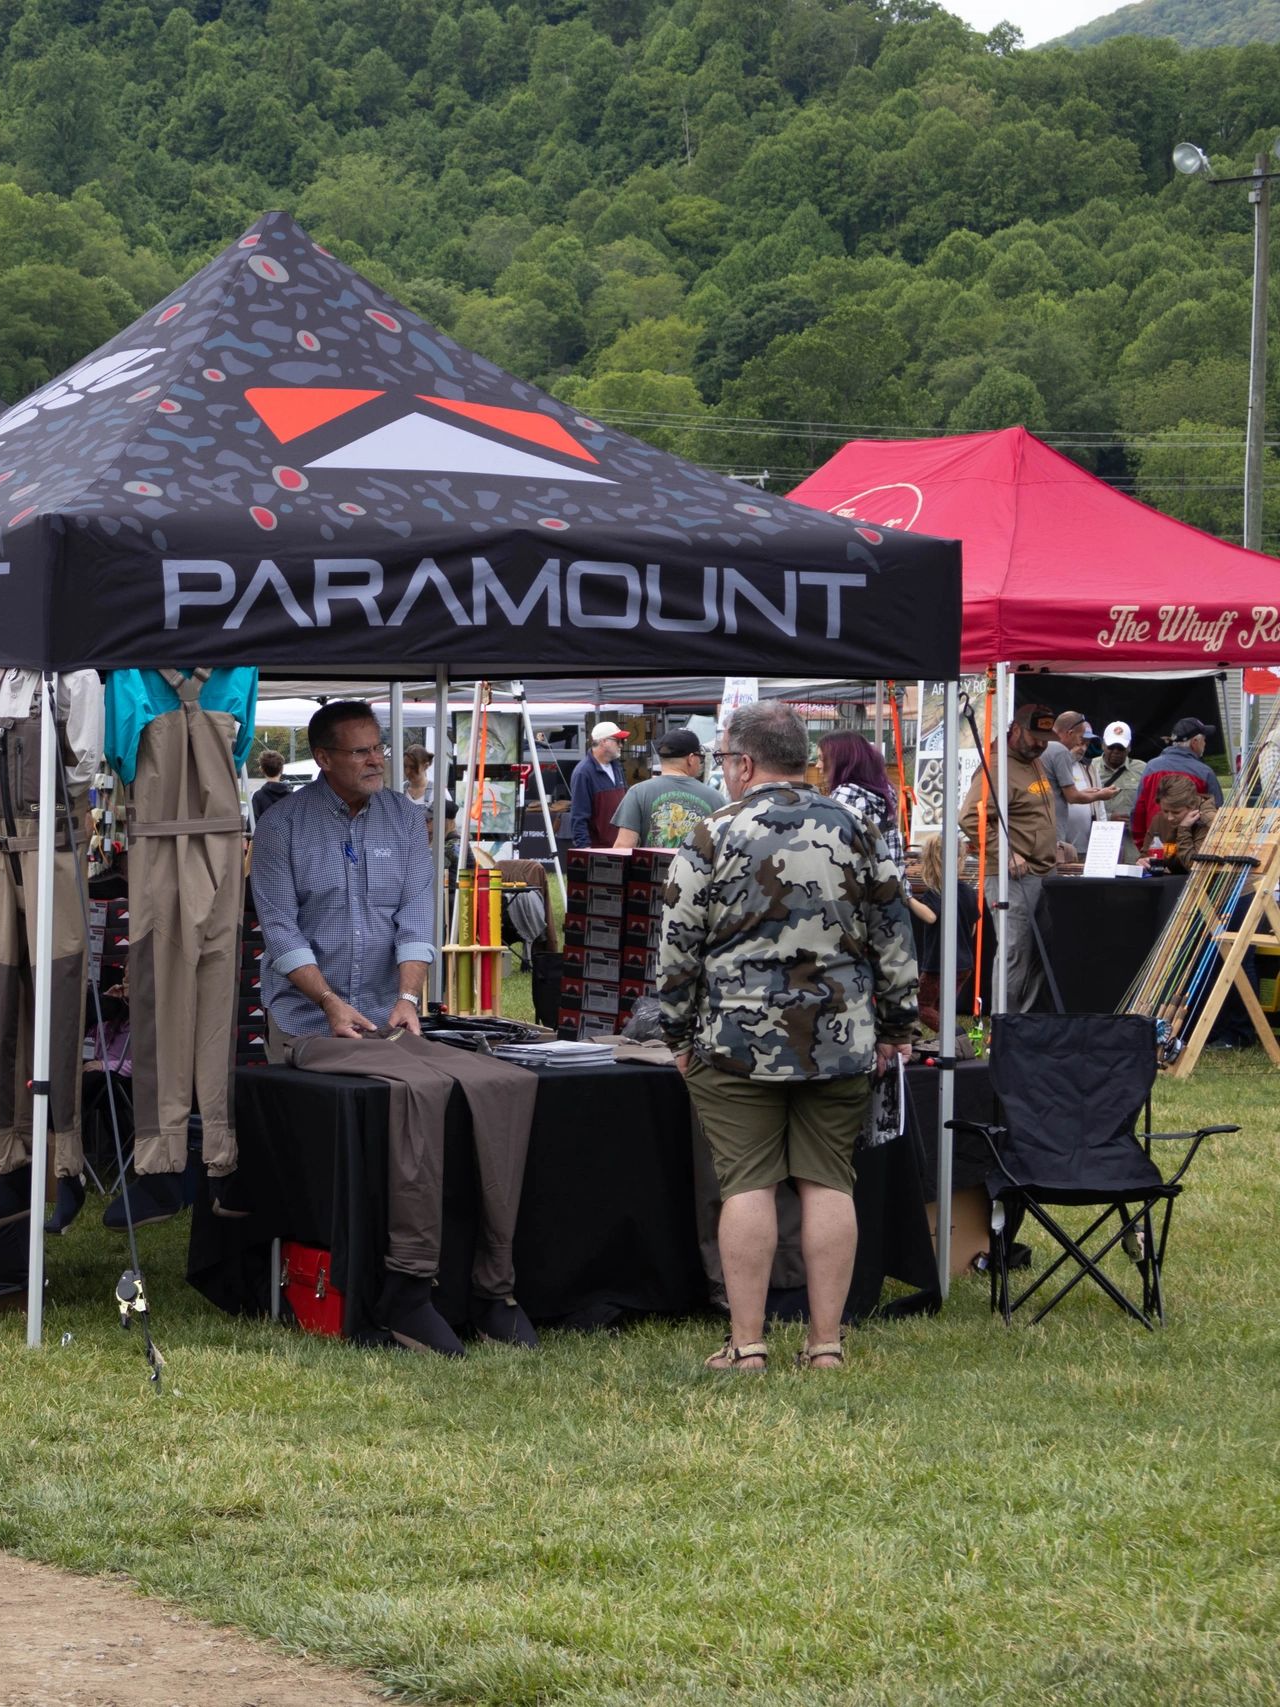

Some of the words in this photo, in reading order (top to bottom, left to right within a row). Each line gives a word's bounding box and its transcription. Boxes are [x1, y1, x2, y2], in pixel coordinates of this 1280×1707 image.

[162, 557, 867, 639] PARAMOUNT
[1097, 605, 1151, 648] The
[1157, 605, 1239, 652] Whuff
[1237, 606, 1280, 649] Ro
